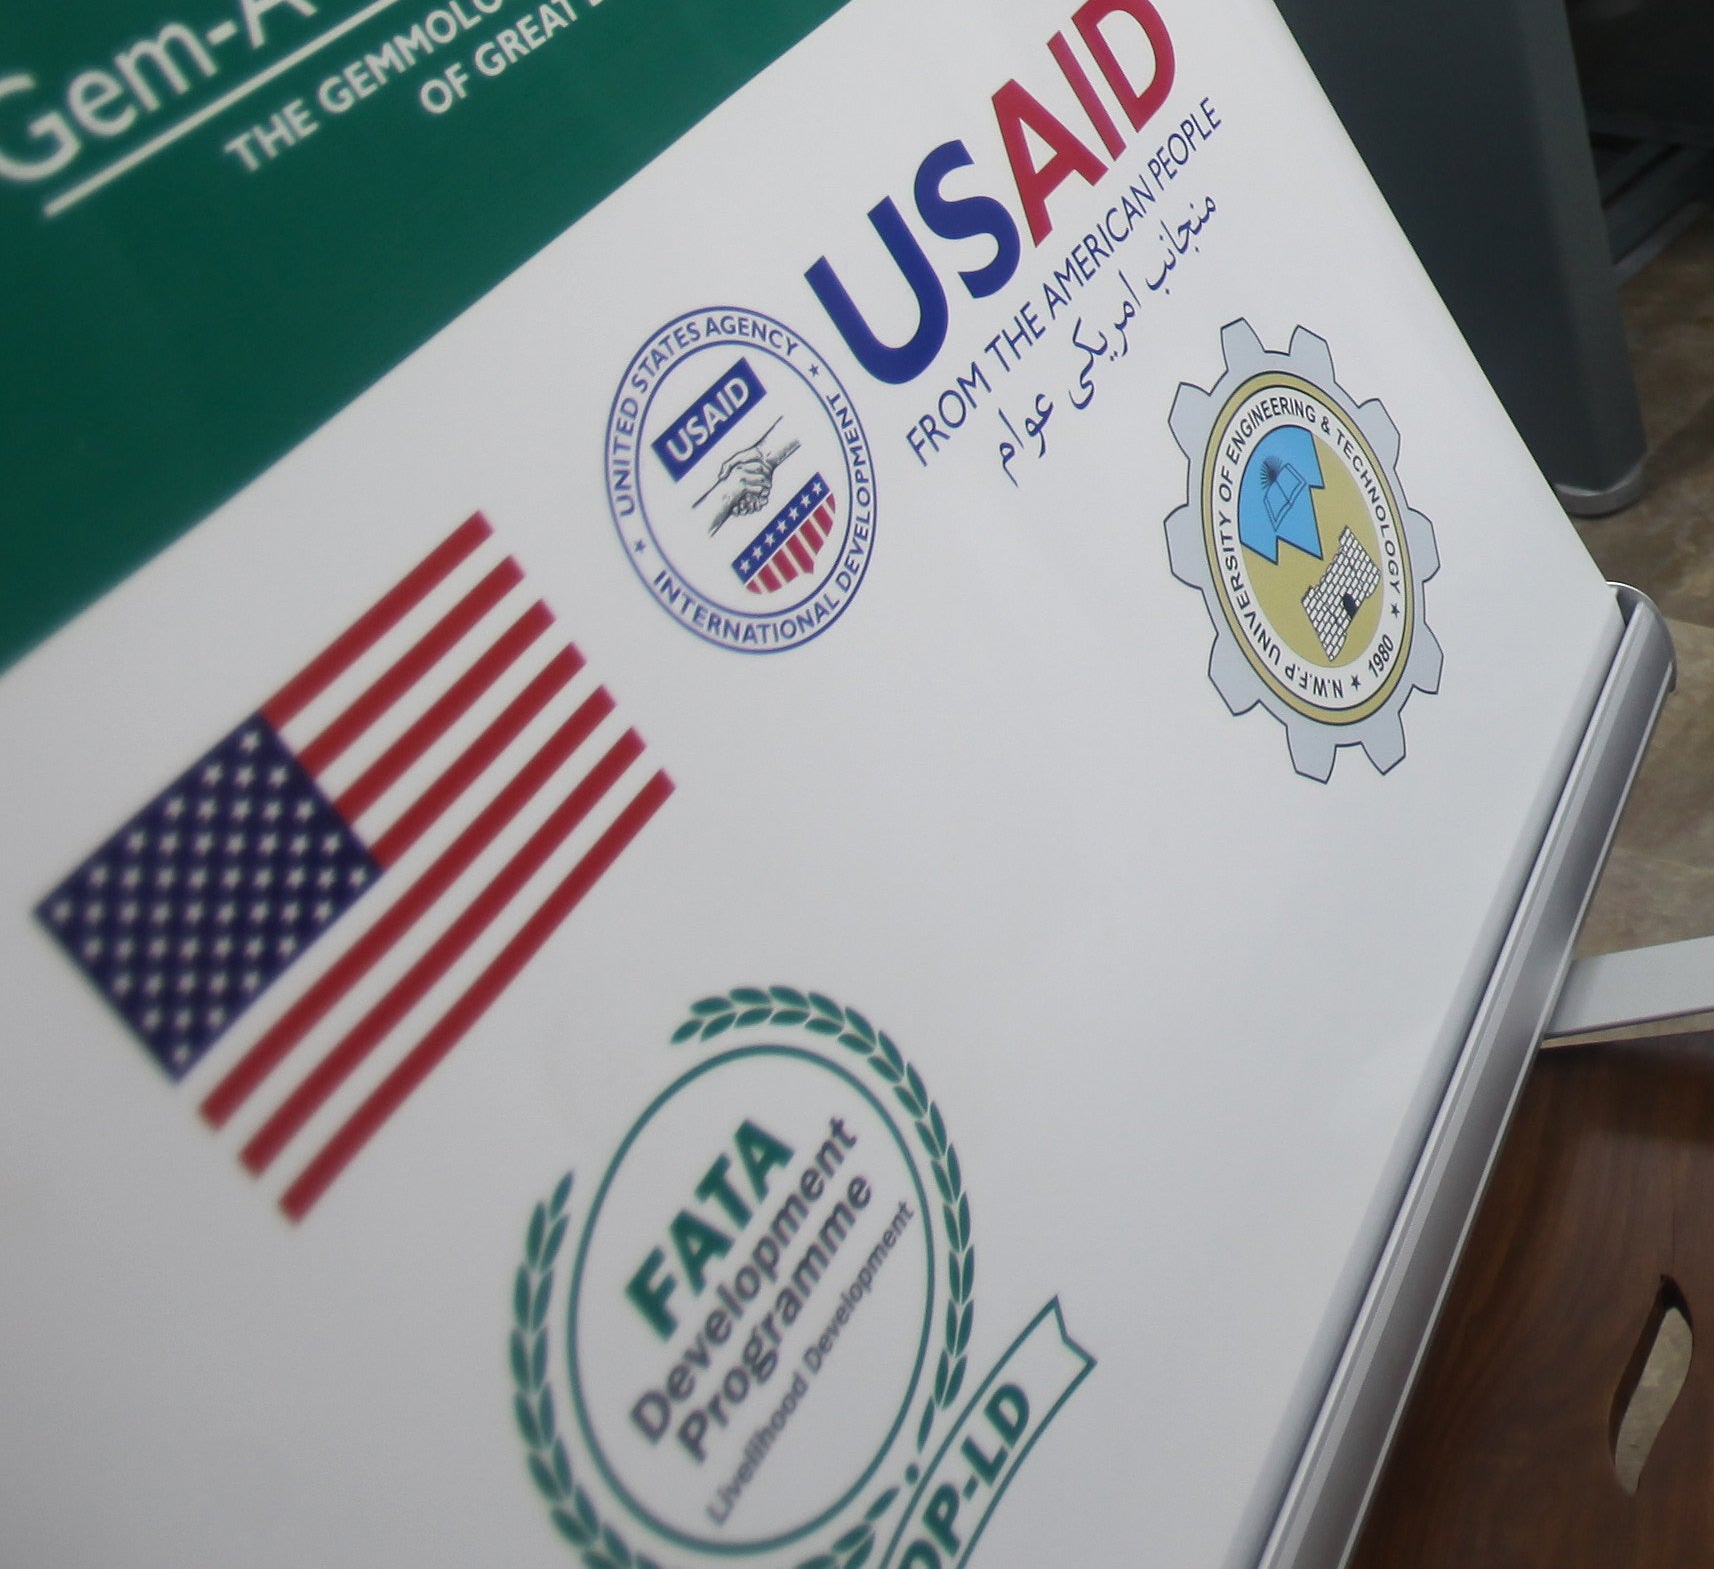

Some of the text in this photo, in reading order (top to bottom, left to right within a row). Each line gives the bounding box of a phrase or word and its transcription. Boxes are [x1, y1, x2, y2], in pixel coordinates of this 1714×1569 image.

[225, 98, 318, 173] THE
[420, 72, 470, 116] OF
[906, 95, 1223, 468] FROM THE AMERICAN PEOPLE
[612, 315, 799, 517] UNITED STATES AGENCY
[665, 376, 751, 462] USAID
[998, 394, 1054, 488] عوام
[1218, 465, 1236, 503] OF
[1226, 396, 1316, 465] ENGINEERING
[1320, 415, 1331, 436] &
[653, 392, 870, 644] INTERNATIONAL DEVELOPMENT
[1218, 511, 1281, 666] UNIVERSITY
[1335, 428, 1401, 594] TECHNOLOGY
[1366, 633, 1394, 678] 1980
[625, 1119, 795, 1343] FATA
[630, 1115, 858, 1446] Development
[675, 1175, 872, 1465] Programme
[706, 1201, 916, 1528] Livelihood Development
